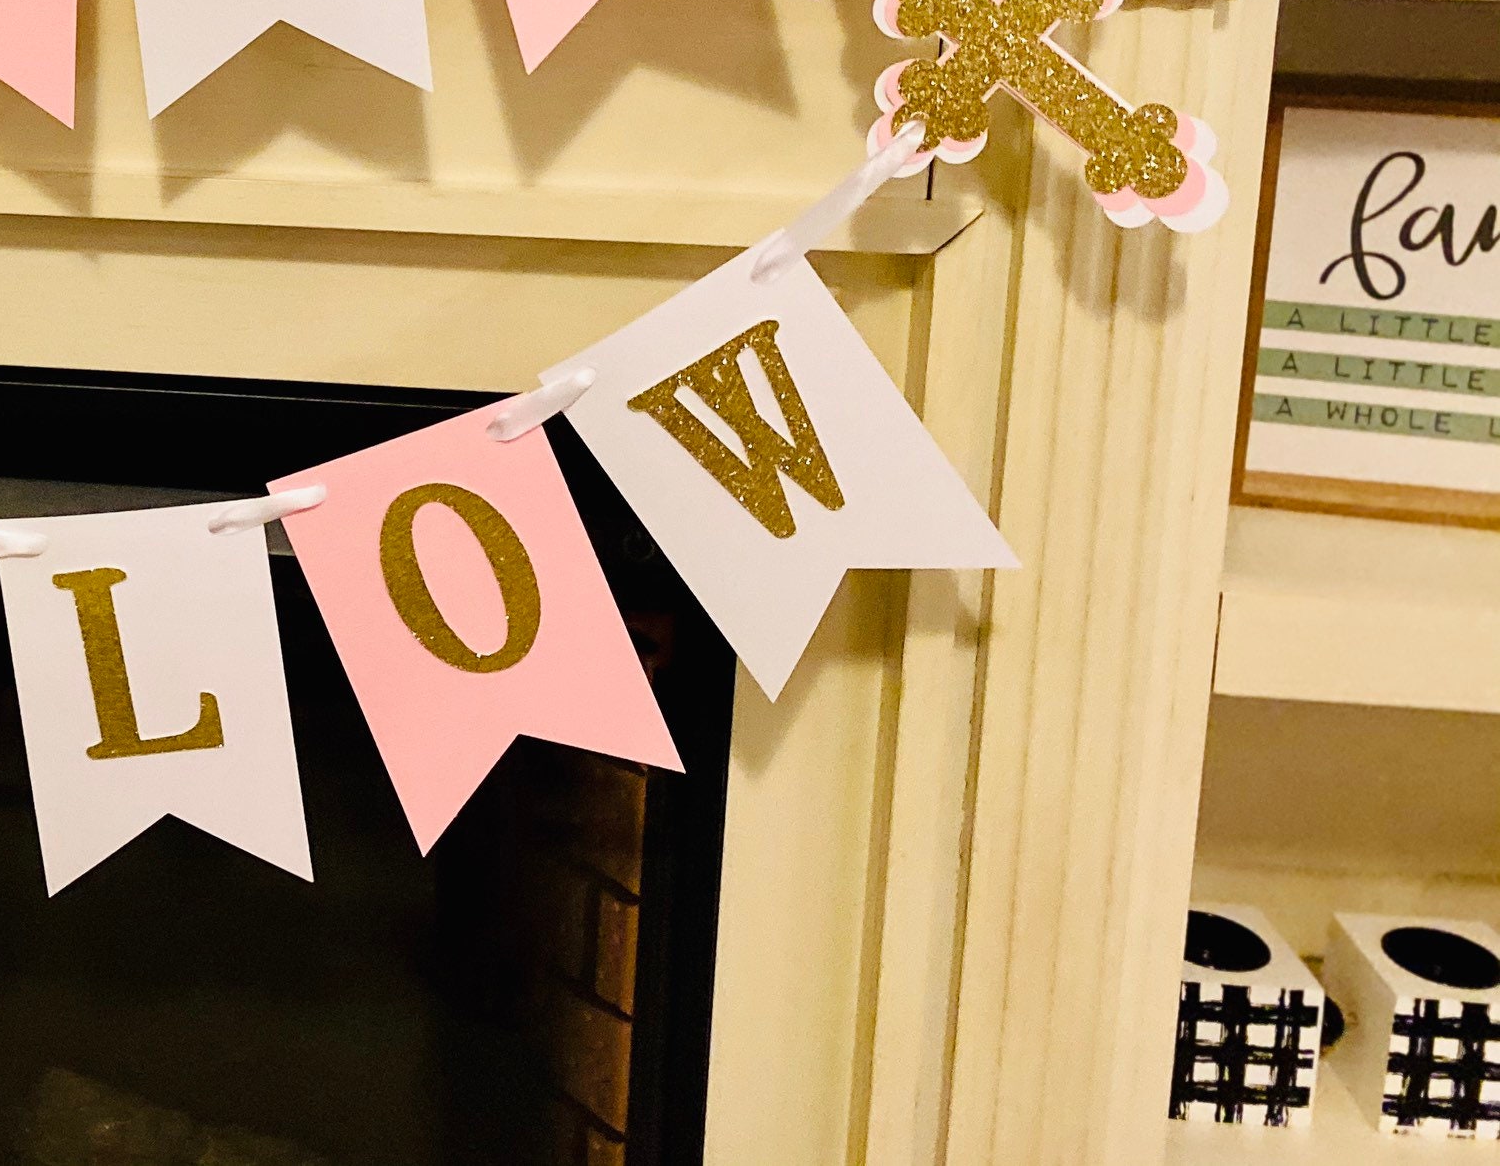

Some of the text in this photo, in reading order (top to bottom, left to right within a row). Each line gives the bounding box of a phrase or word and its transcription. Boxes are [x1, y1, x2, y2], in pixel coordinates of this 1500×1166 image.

[1286, 308, 1492, 345] A LITTLE
[1281, 353, 1485, 391] A LITTLE
[1276, 398, 1293, 417] A
[1327, 401, 1451, 434] WHOLE
